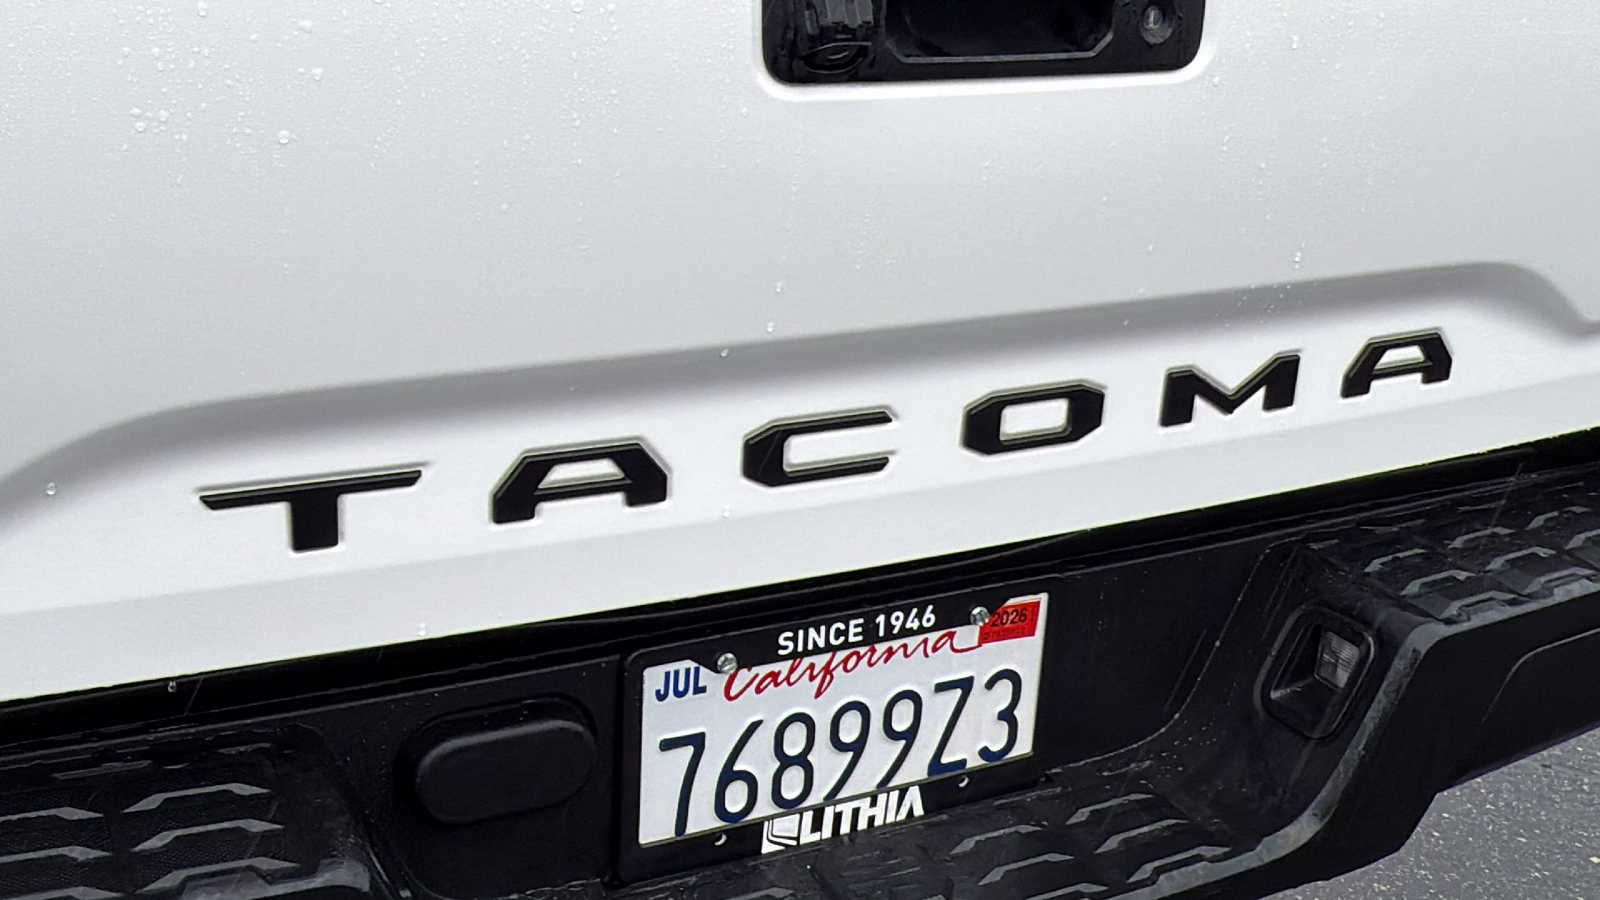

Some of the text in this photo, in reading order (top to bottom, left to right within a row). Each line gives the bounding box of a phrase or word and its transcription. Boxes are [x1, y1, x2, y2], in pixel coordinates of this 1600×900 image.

[198, 328, 1453, 554] TACOMA
[776, 605, 936, 656] SINCE 1946
[989, 607, 1029, 628] 2026
[655, 666, 707, 702] JUL
[723, 629, 983, 702] California
[659, 668, 1023, 837] 76899Z3
[796, 785, 925, 844] LITHIA
